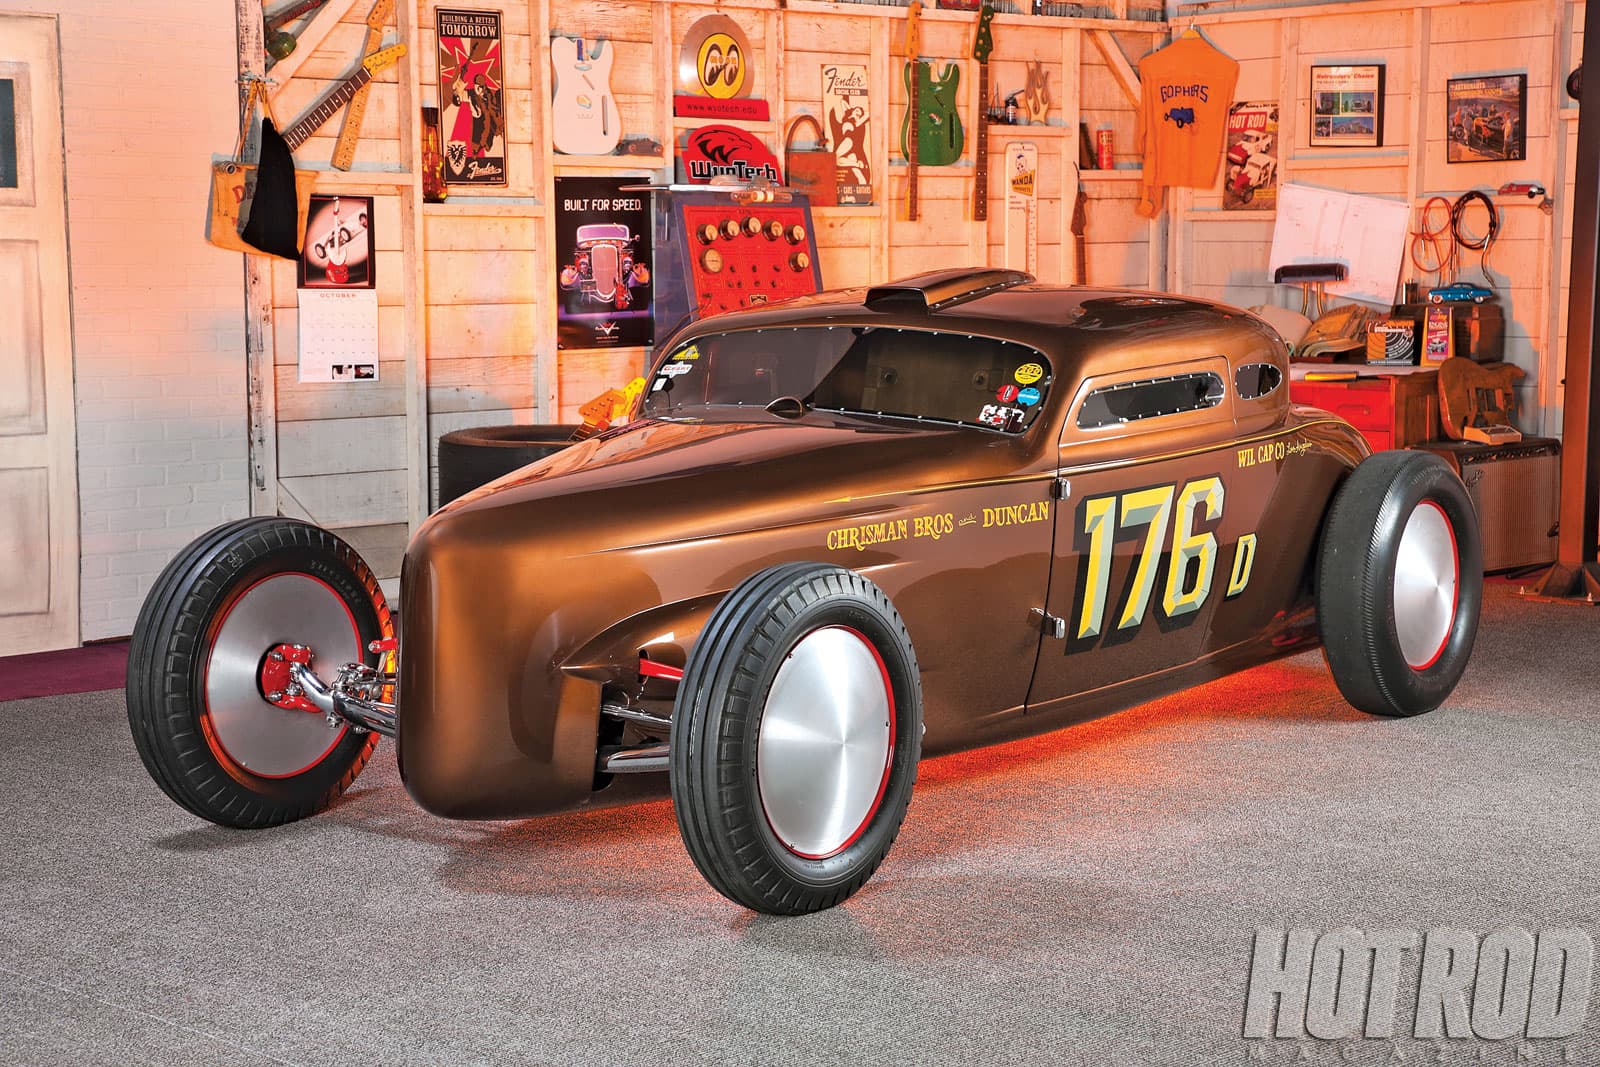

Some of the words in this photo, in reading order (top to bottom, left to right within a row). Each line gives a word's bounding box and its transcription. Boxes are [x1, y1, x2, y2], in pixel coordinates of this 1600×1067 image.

[441, 15, 468, 23] BUILDING
[475, 16, 495, 25] BETTER
[441, 23, 497, 37] TOMORROW
[825, 67, 863, 94] Fender
[1160, 84, 1209, 104] GOPHERS
[686, 102, 758, 114] www.wyotech.edu
[1229, 114, 1247, 129] HOT
[1247, 114, 1266, 129] ROD
[466, 161, 502, 179] Fender
[690, 160, 777, 180] WyoTech
[1012, 174, 1033, 185] WANDA
[564, 199, 589, 211] BUILT
[592, 199, 609, 211] FOR
[612, 198, 642, 211] SPEED.
[1237, 448, 1255, 468] WIL
[1258, 443, 1274, 463] CAP
[1275, 441, 1285, 460] CO
[827, 519, 908, 551] CHRISMAN
[913, 512, 954, 540] BROS
[958, 513, 977, 527] and
[982, 501, 1050, 528] DUNCAN
[1077, 477, 1225, 640] 176
[1226, 533, 1257, 597] D
